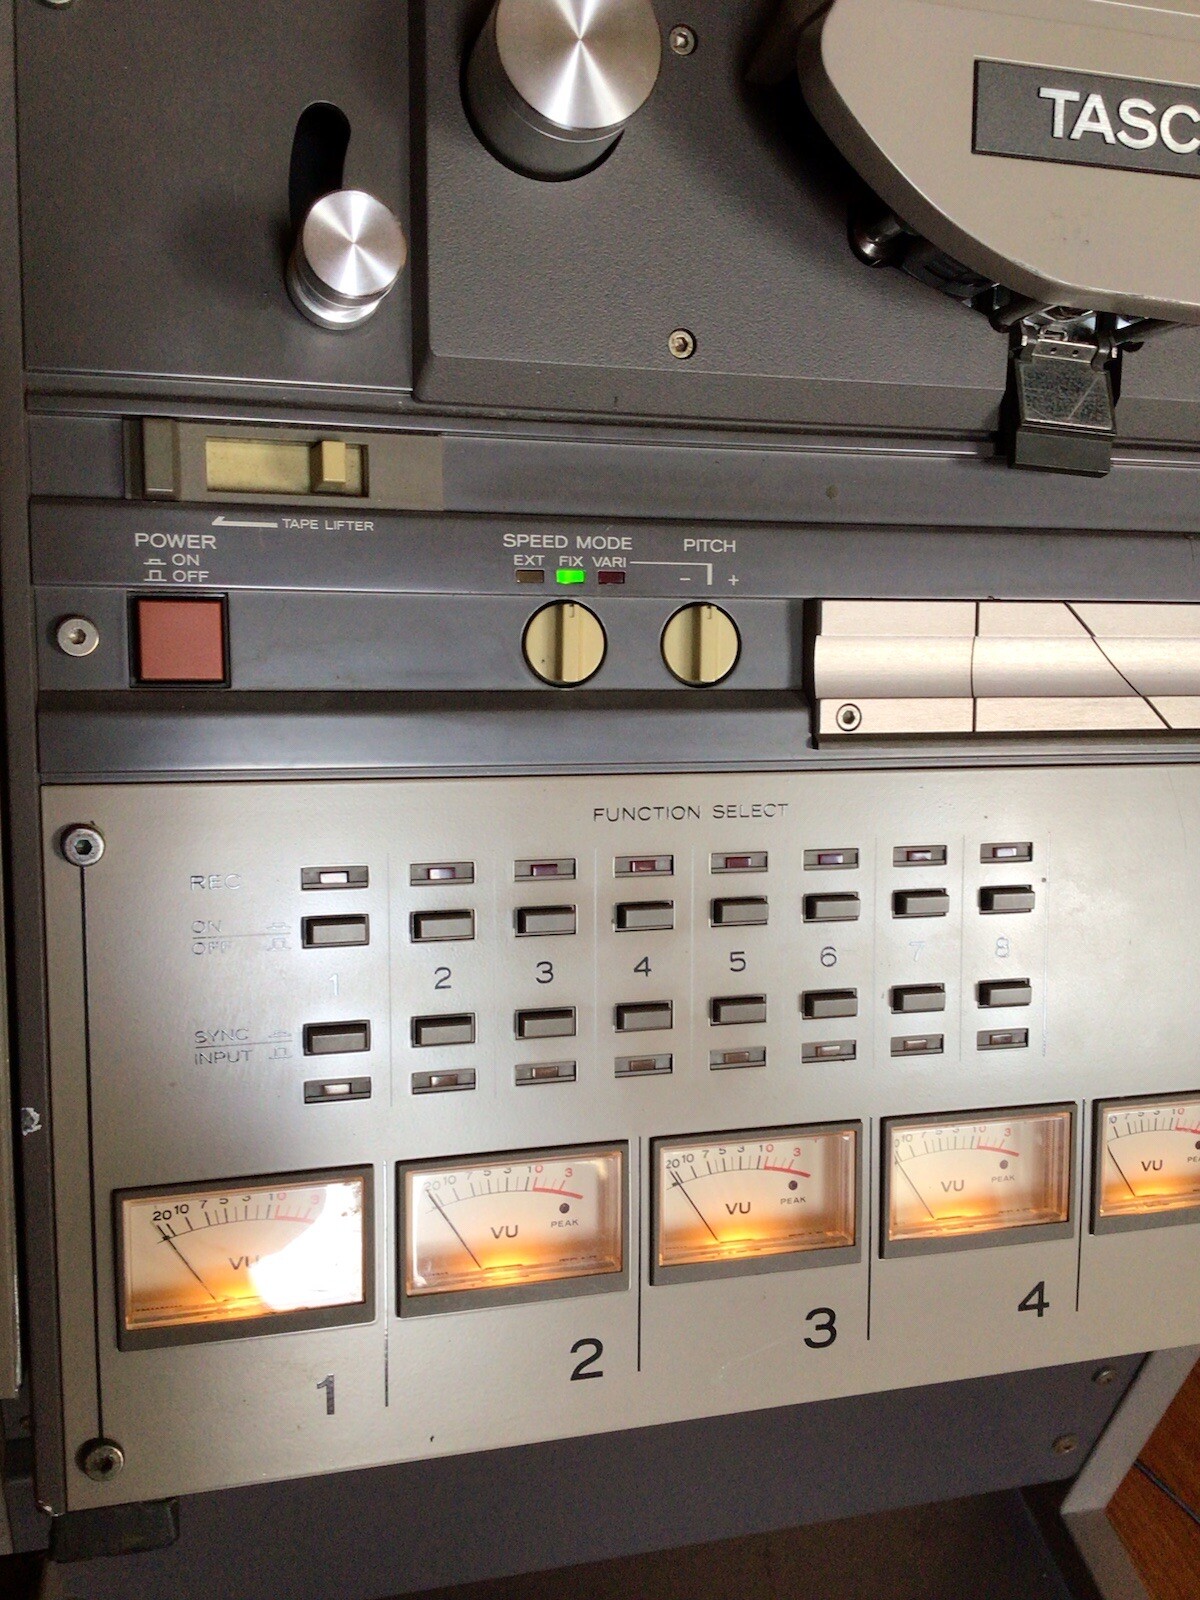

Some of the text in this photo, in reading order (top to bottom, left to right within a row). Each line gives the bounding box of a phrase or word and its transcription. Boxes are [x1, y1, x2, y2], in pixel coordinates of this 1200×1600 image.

[282, 518, 374, 531] TAPE LIFTER
[134, 533, 217, 549] POWER
[503, 533, 633, 550] SPEED MODE
[683, 539, 736, 552] PITCH
[172, 553, 200, 566] ON
[513, 555, 627, 568] EXT FIX VARI
[172, 570, 209, 582] OFF
[593, 803, 789, 822] FUNCTION SELECT
[190, 873, 242, 891] REC
[191, 920, 222, 934] ON
[328, 937, 1010, 996] 1 2 3 4 5 6 7 8
[194, 1028, 250, 1043] SYNC
[194, 1049, 254, 1065] INPUT
[666, 1159, 680, 1169] 20
[682, 1154, 694, 1163] 10
[793, 1147, 801, 1157] 3
[1141, 1160, 1163, 1171] VU
[565, 1168, 573, 1177] 3
[991, 1174, 1016, 1183] PEAK
[941, 1179, 965, 1193] VU
[725, 1201, 751, 1215] VU
[780, 1196, 807, 1205] PEAK
[153, 1210, 172, 1221] 20
[174, 1204, 189, 1215] 10
[551, 1218, 579, 1228] PEAK
[491, 1224, 519, 1239] VU
[1017, 1281, 1050, 1318] 4
[804, 1307, 837, 1349] 3
[570, 1337, 604, 1381] 2
[316, 1373, 335, 1415] 1
